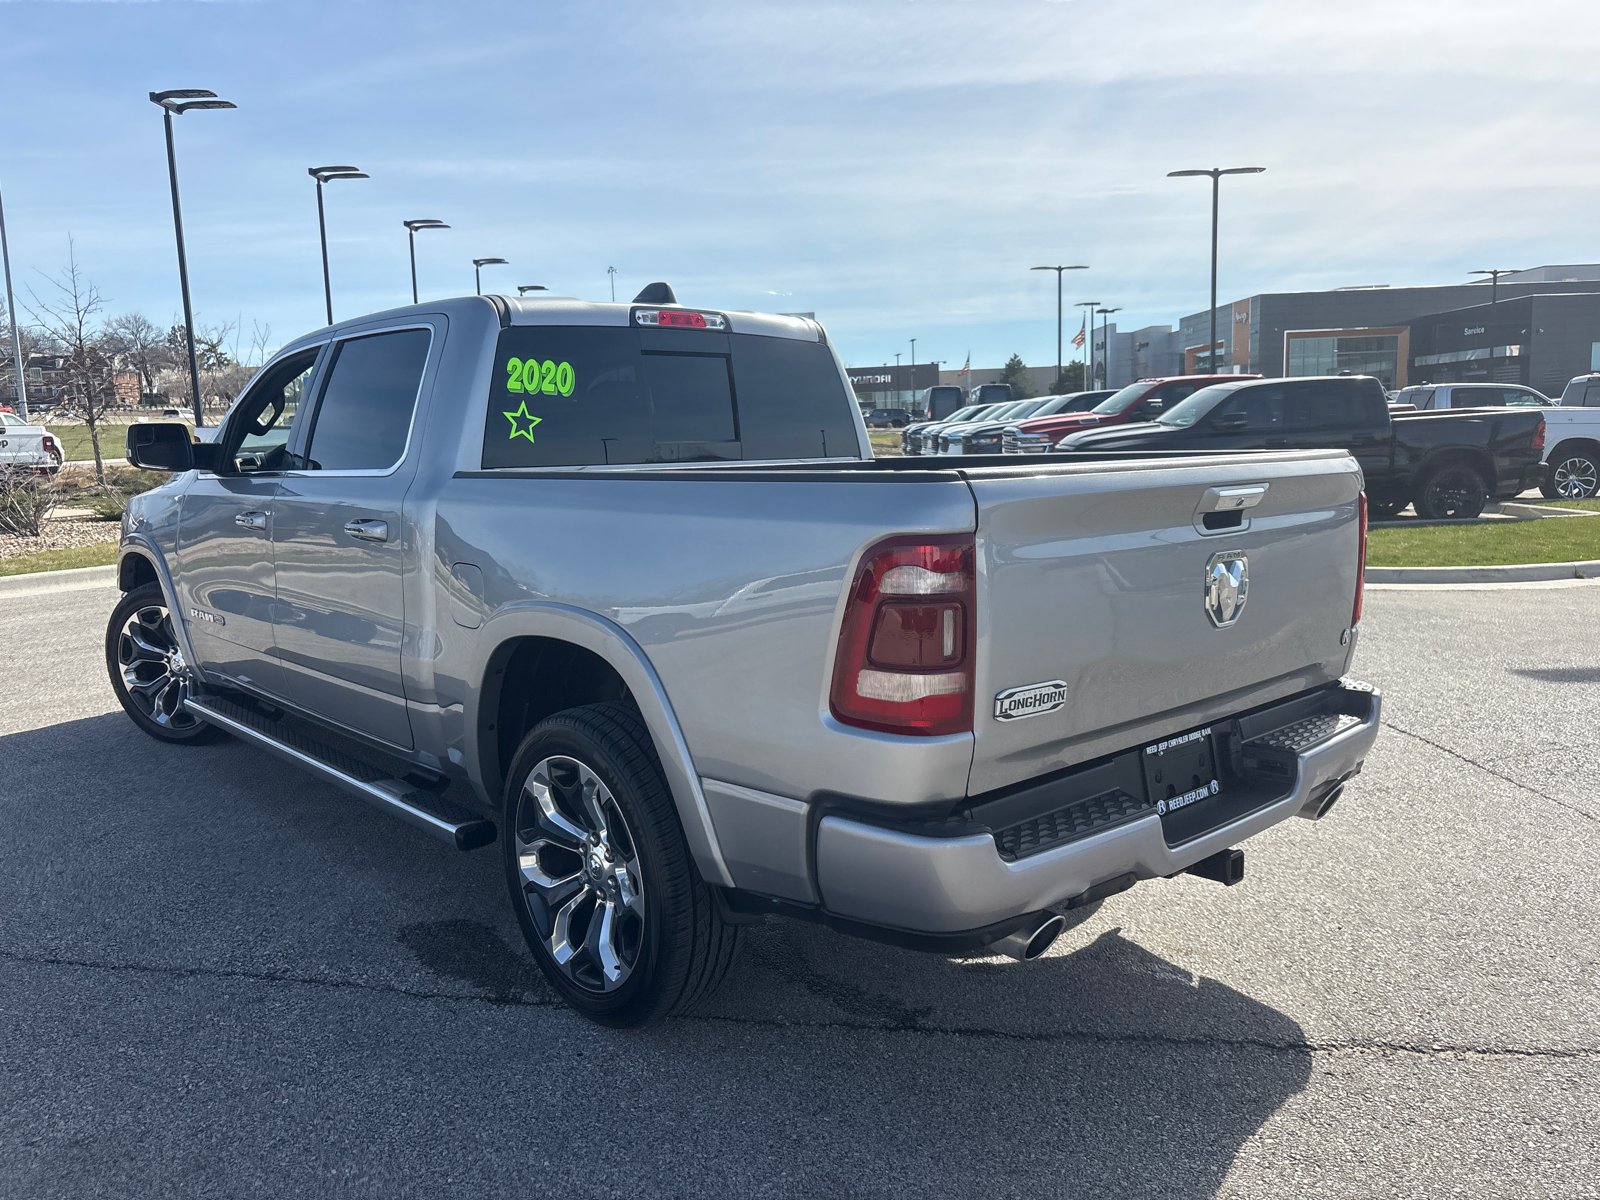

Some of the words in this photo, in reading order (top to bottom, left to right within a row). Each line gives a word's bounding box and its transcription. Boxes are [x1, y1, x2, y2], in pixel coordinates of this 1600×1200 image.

[1464, 326, 1485, 335] Service
[507, 357, 575, 397] 2020
[1217, 552, 1241, 560] RAM
[191, 608, 214, 622] RAM
[1146, 745, 1157, 754] REED
[1158, 741, 1167, 751] JEEP
[1168, 735, 1188, 747] CHRYSLER
[1189, 730, 1201, 740] DODGE
[1202, 727, 1211, 736] RAM
[1168, 787, 1208, 811] REEDJEEP.COM
